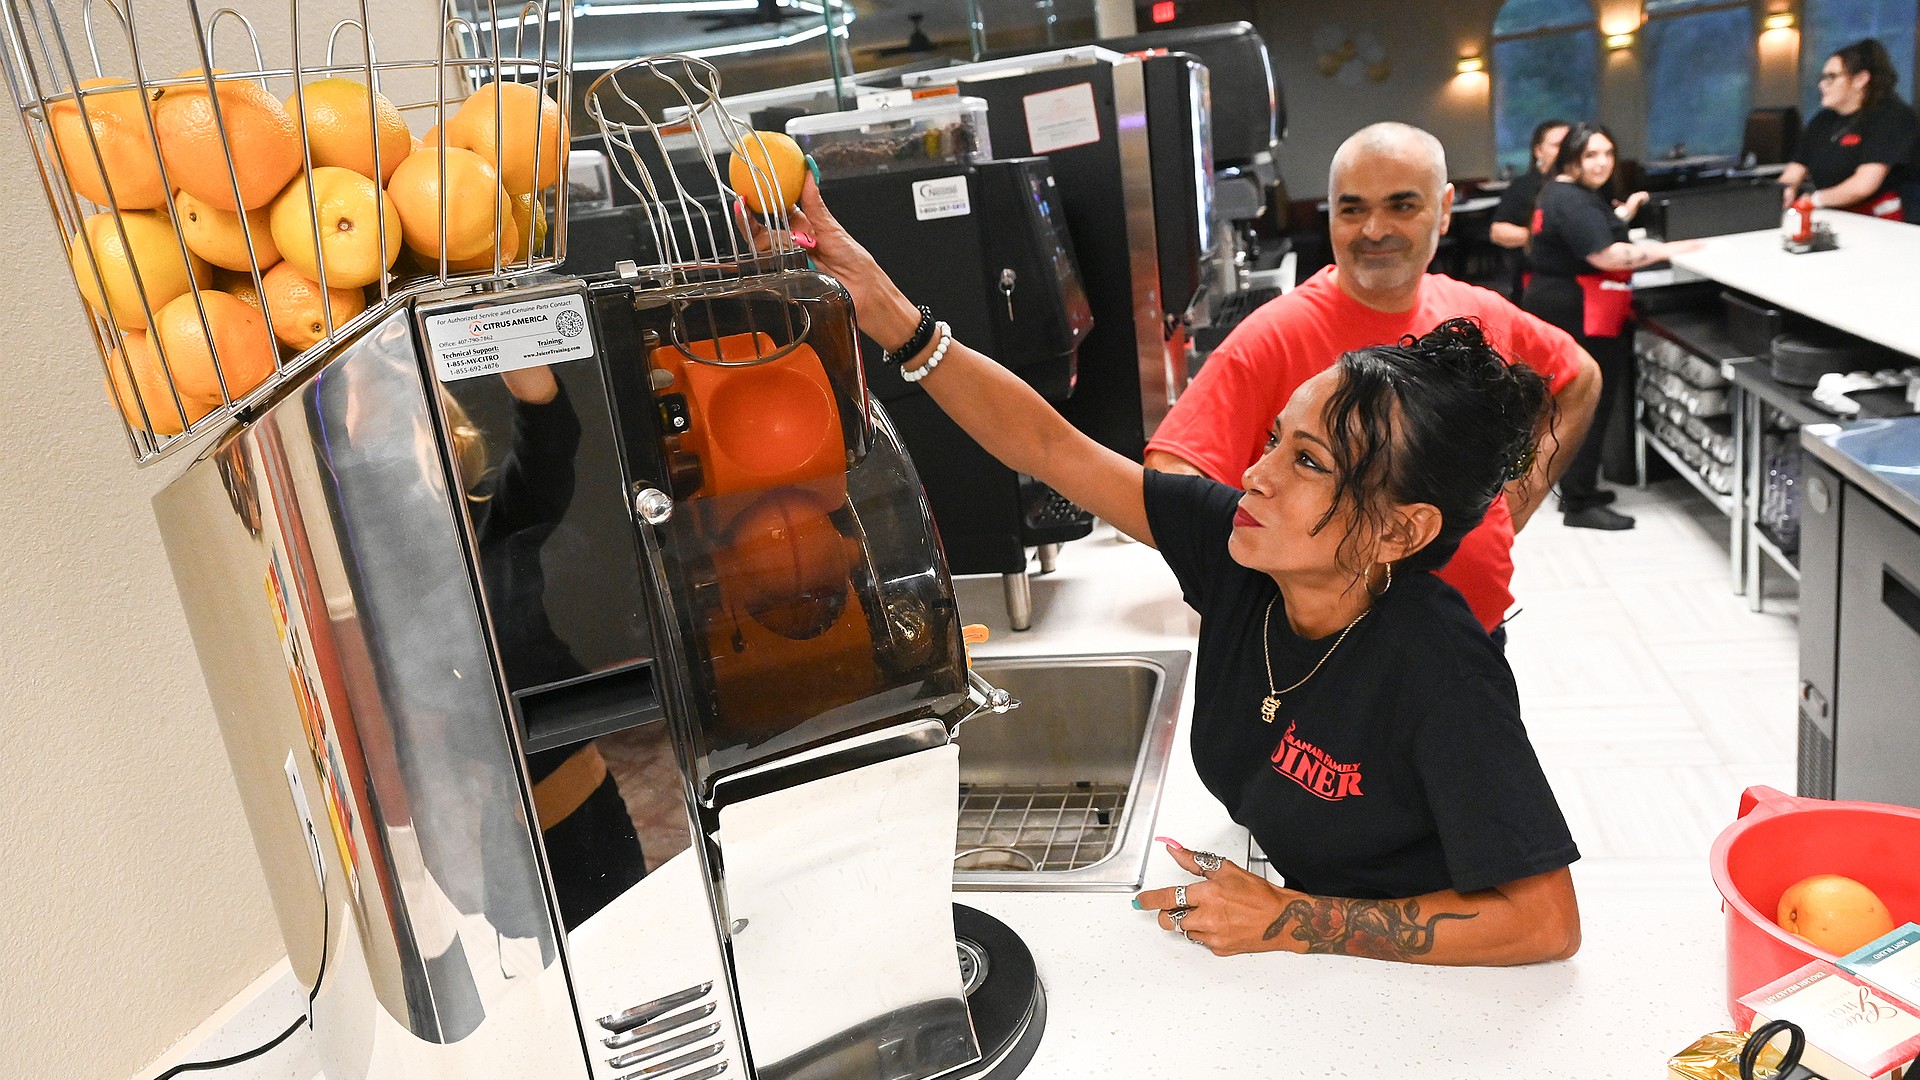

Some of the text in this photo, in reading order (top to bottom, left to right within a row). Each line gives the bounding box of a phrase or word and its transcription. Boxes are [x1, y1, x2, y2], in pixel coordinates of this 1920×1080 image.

[436, 300, 573, 326] For Authorized Service and Genuine Parts Contact:
[482, 314, 549, 332] CITRUS AMERICA
[457, 335, 494, 346] 407-790-7862
[537, 337, 564, 348] Training:
[442, 345, 500, 360] Technical Support:
[523, 345, 581, 359] www.JuicerTraining.com
[446, 354, 499, 368] 1-855-MY-CITRO
[449, 362, 500, 376] 1-855-692-4876
[1324, 753, 1361, 772] FAMILY
[1872, 938, 1909, 960] MINT BLEND
[1797, 971, 1827, 989] ENGLISH
[1765, 982, 1799, 1004] BREAKFAST
